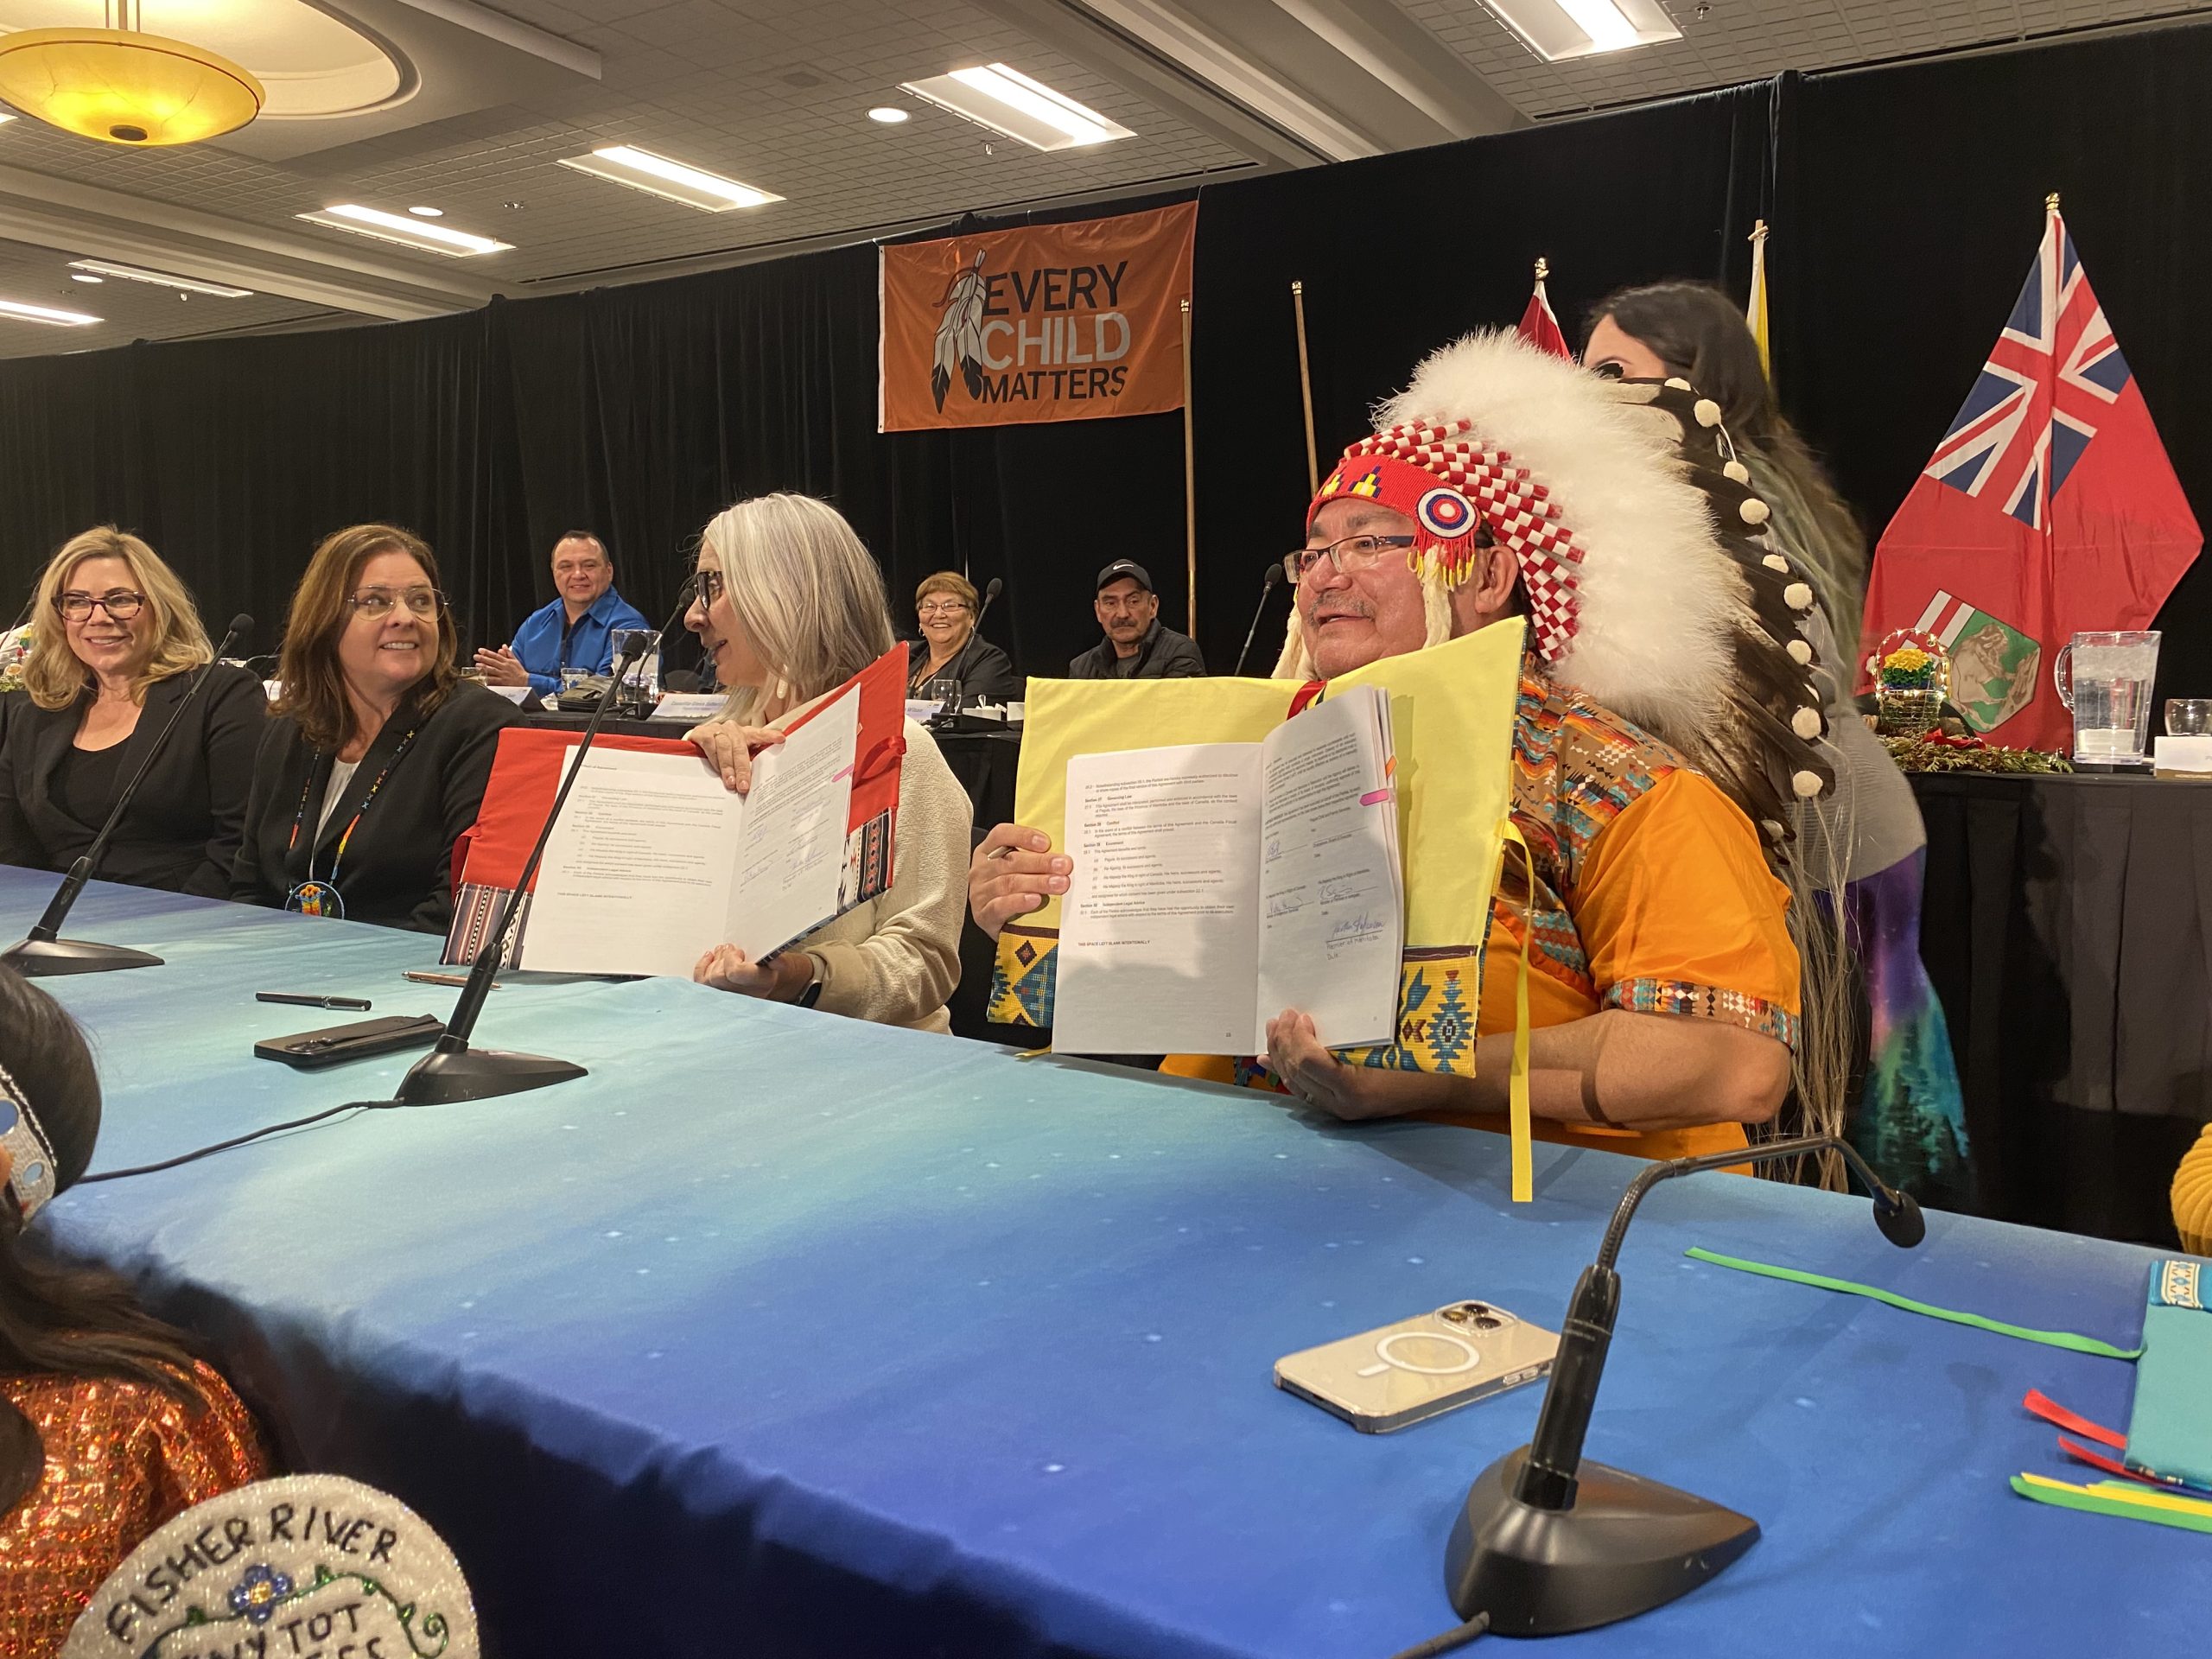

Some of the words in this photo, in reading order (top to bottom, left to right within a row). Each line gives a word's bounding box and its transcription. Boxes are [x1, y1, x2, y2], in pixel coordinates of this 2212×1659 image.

[983, 261, 1128, 315] EVERY
[981, 312, 1131, 371] CHILD
[982, 366, 1128, 403] MATTERS
[106, 1517, 255, 1644] FISHER
[270, 1503, 397, 1563] RIVER
[277, 1603, 361, 1654] TOT
